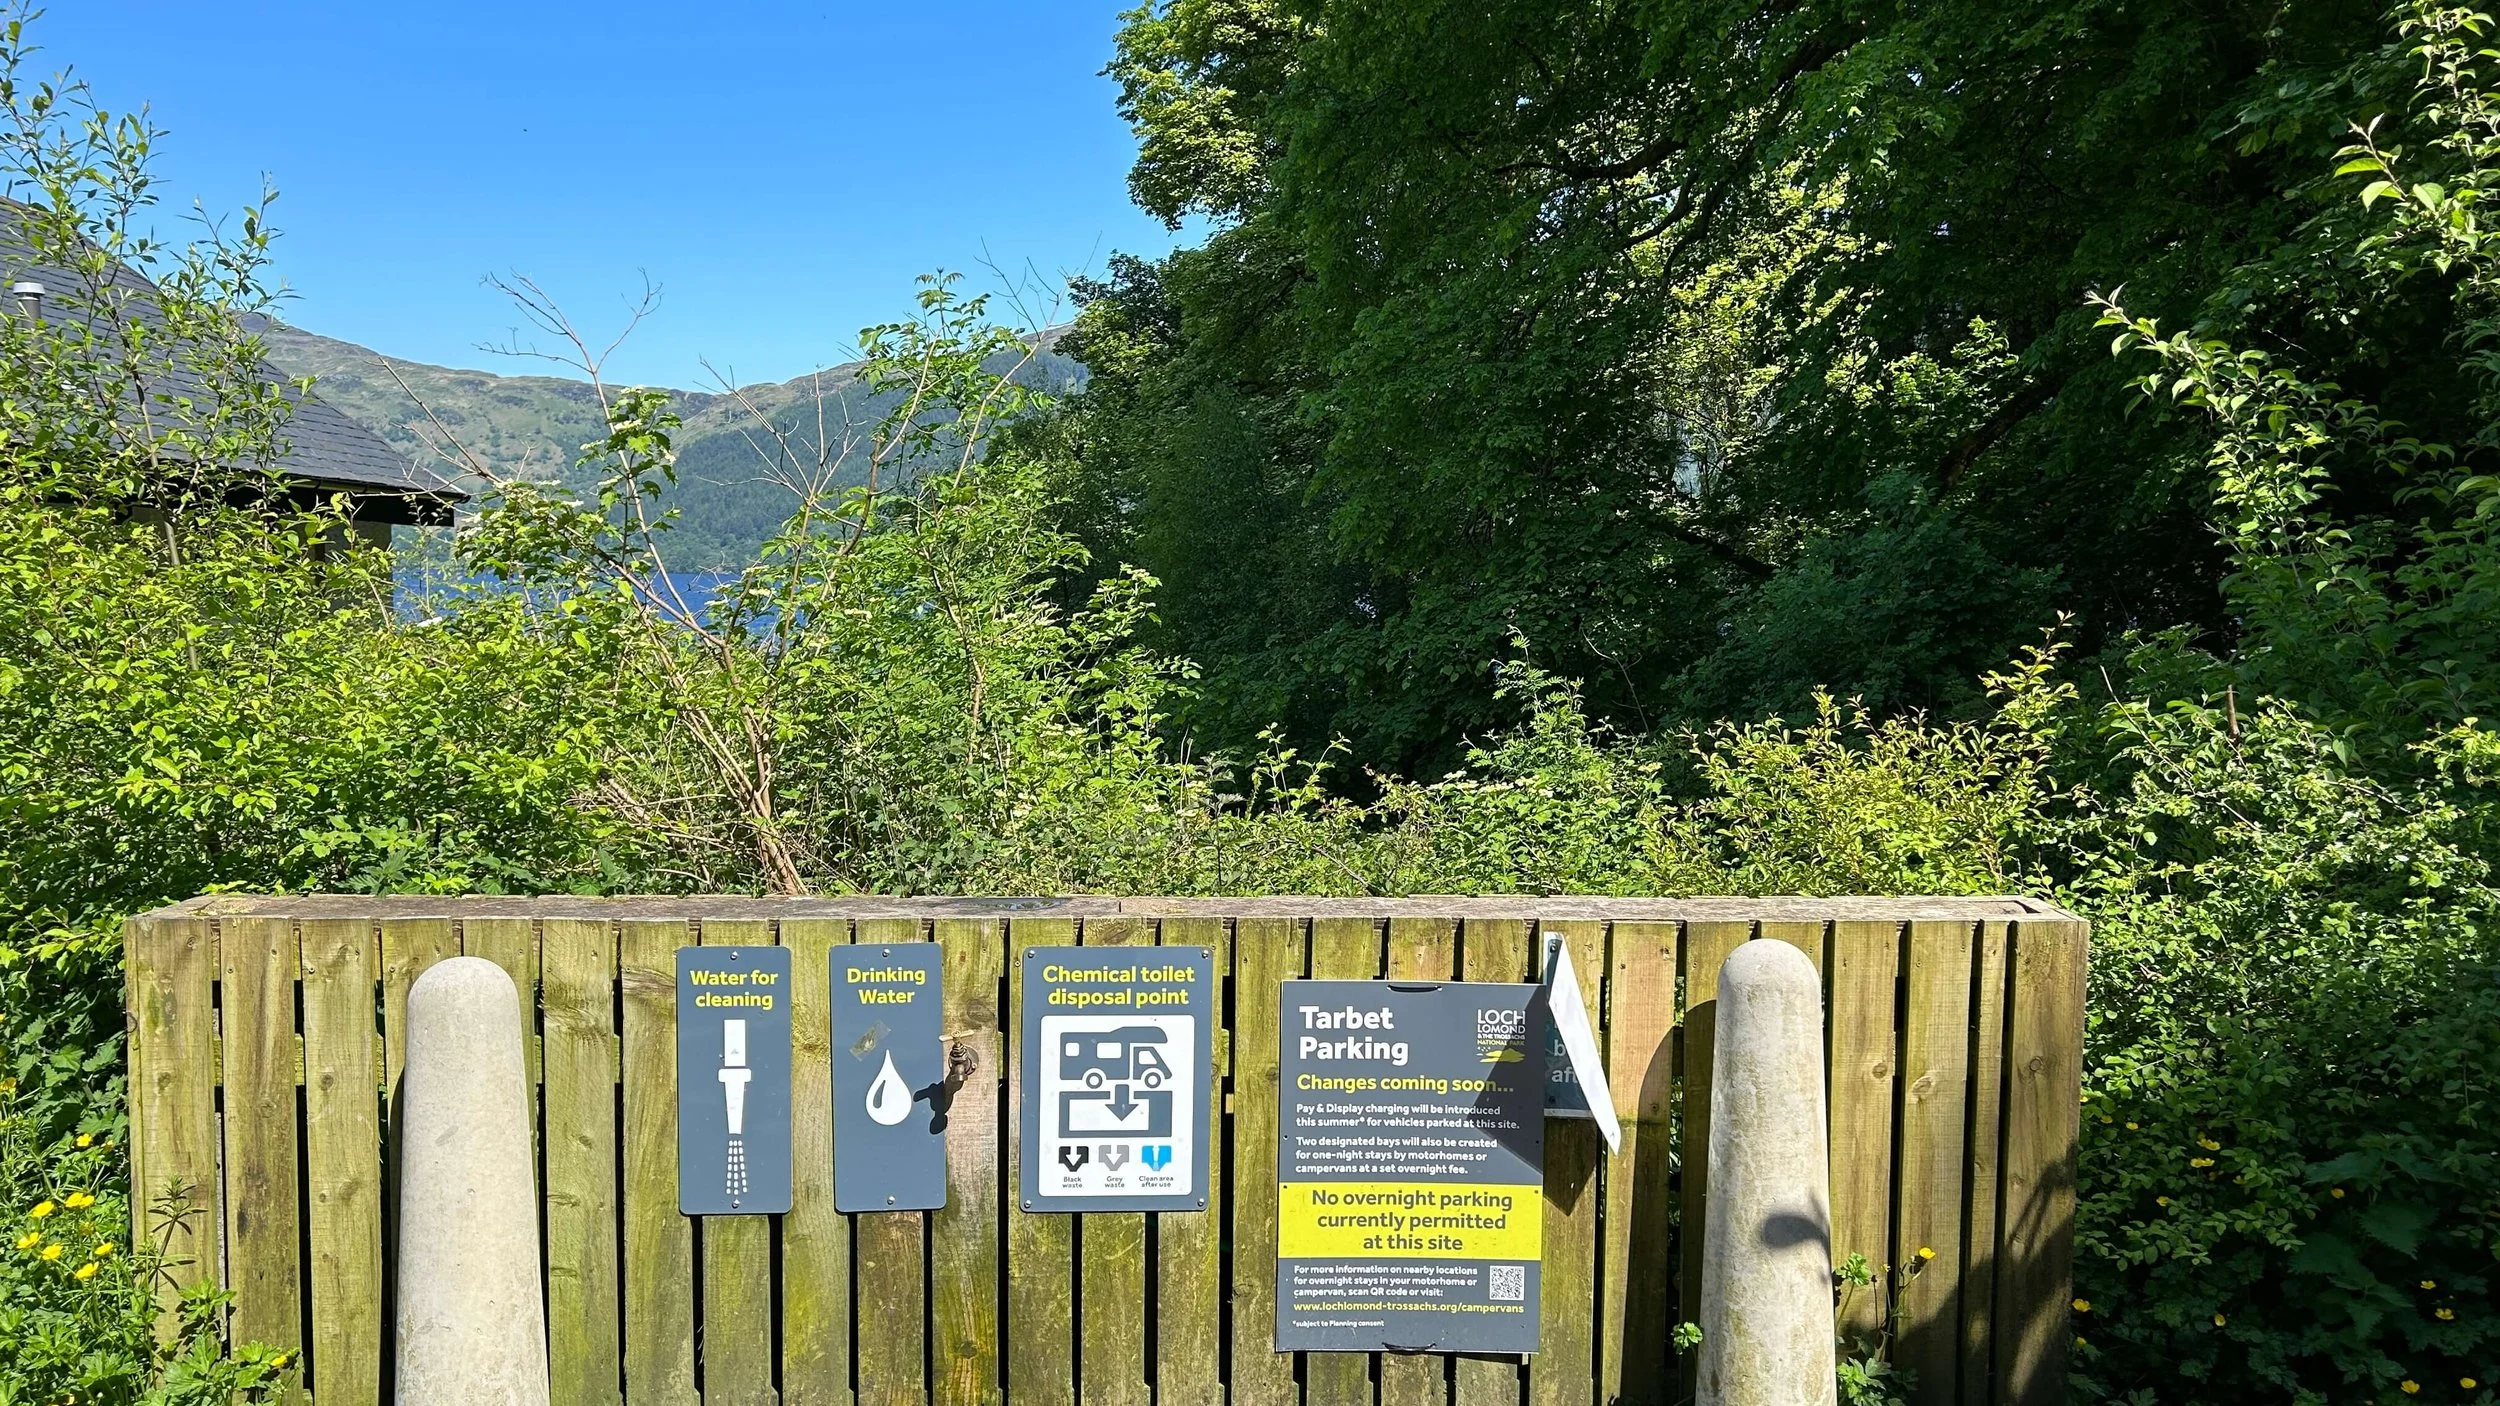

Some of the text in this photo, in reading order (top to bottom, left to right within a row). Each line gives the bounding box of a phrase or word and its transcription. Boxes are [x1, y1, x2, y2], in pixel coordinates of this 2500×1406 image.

[689, 969, 778, 986] Water for
[847, 967, 926, 986] Drinking
[1042, 965, 1195, 982] Chemical toilet
[695, 991, 773, 1011] cleaning
[858, 989, 915, 1005] Water
[1048, 988, 1189, 1009] disposal point
[1299, 1005, 1394, 1030] Tarbet
[1477, 1009, 1526, 1025] LOCH
[1477, 1024, 1526, 1034] LOMOND
[1300, 1036, 1409, 1066] Parking
[1297, 1074, 1514, 1094] Changes coming soon...
[1296, 1104, 1501, 1116] Pay & Display charging will be introduced
[1296, 1117, 1316, 1127] this
[1366, 1117, 1382, 1127] for
[1384, 1117, 1424, 1127] vehicles
[1427, 1118, 1462, 1129] parked
[1463, 1119, 1475, 1128] at
[1476, 1119, 1496, 1128] this
[1498, 1120, 1520, 1129] site.
[1295, 1136, 1497, 1148] Two designated bays will also be created
[1295, 1150, 1487, 1162] for one-night stays by motorhomes or
[1295, 1165, 1357, 1175] campervans
[1359, 1164, 1370, 1173] at
[1379, 1164, 1396, 1173] set
[1397, 1164, 1447, 1175] overnight
[1448, 1165, 1468, 1174] fee.
[1312, 1189, 1513, 1210] No overnight parking
[1317, 1212, 1507, 1232] currently permitted
[1363, 1234, 1463, 1251] at this site
[1294, 1265, 1309, 1273] For
[1310, 1266, 1334, 1274] more
[1335, 1265, 1389, 1274] information
[1403, 1266, 1434, 1276] nearby
[1436, 1266, 1478, 1275] locations
[1293, 1276, 1308, 1285] for
[1308, 1276, 1353, 1286] overnight
[1354, 1277, 1379, 1286] stays
[1390, 1278, 1411, 1286] your
[1412, 1277, 1466, 1286] motorhome
[1293, 1289, 1347, 1297] campervan,
[1370, 1287, 1384, 1296] QR
[1385, 1287, 1407, 1296] code
[1420, 1288, 1444, 1297] visit:
[1294, 1301, 1524, 1313] www.lochlomond-trossachs.org/campervans
[1329, 1320, 1358, 1328] Planning
